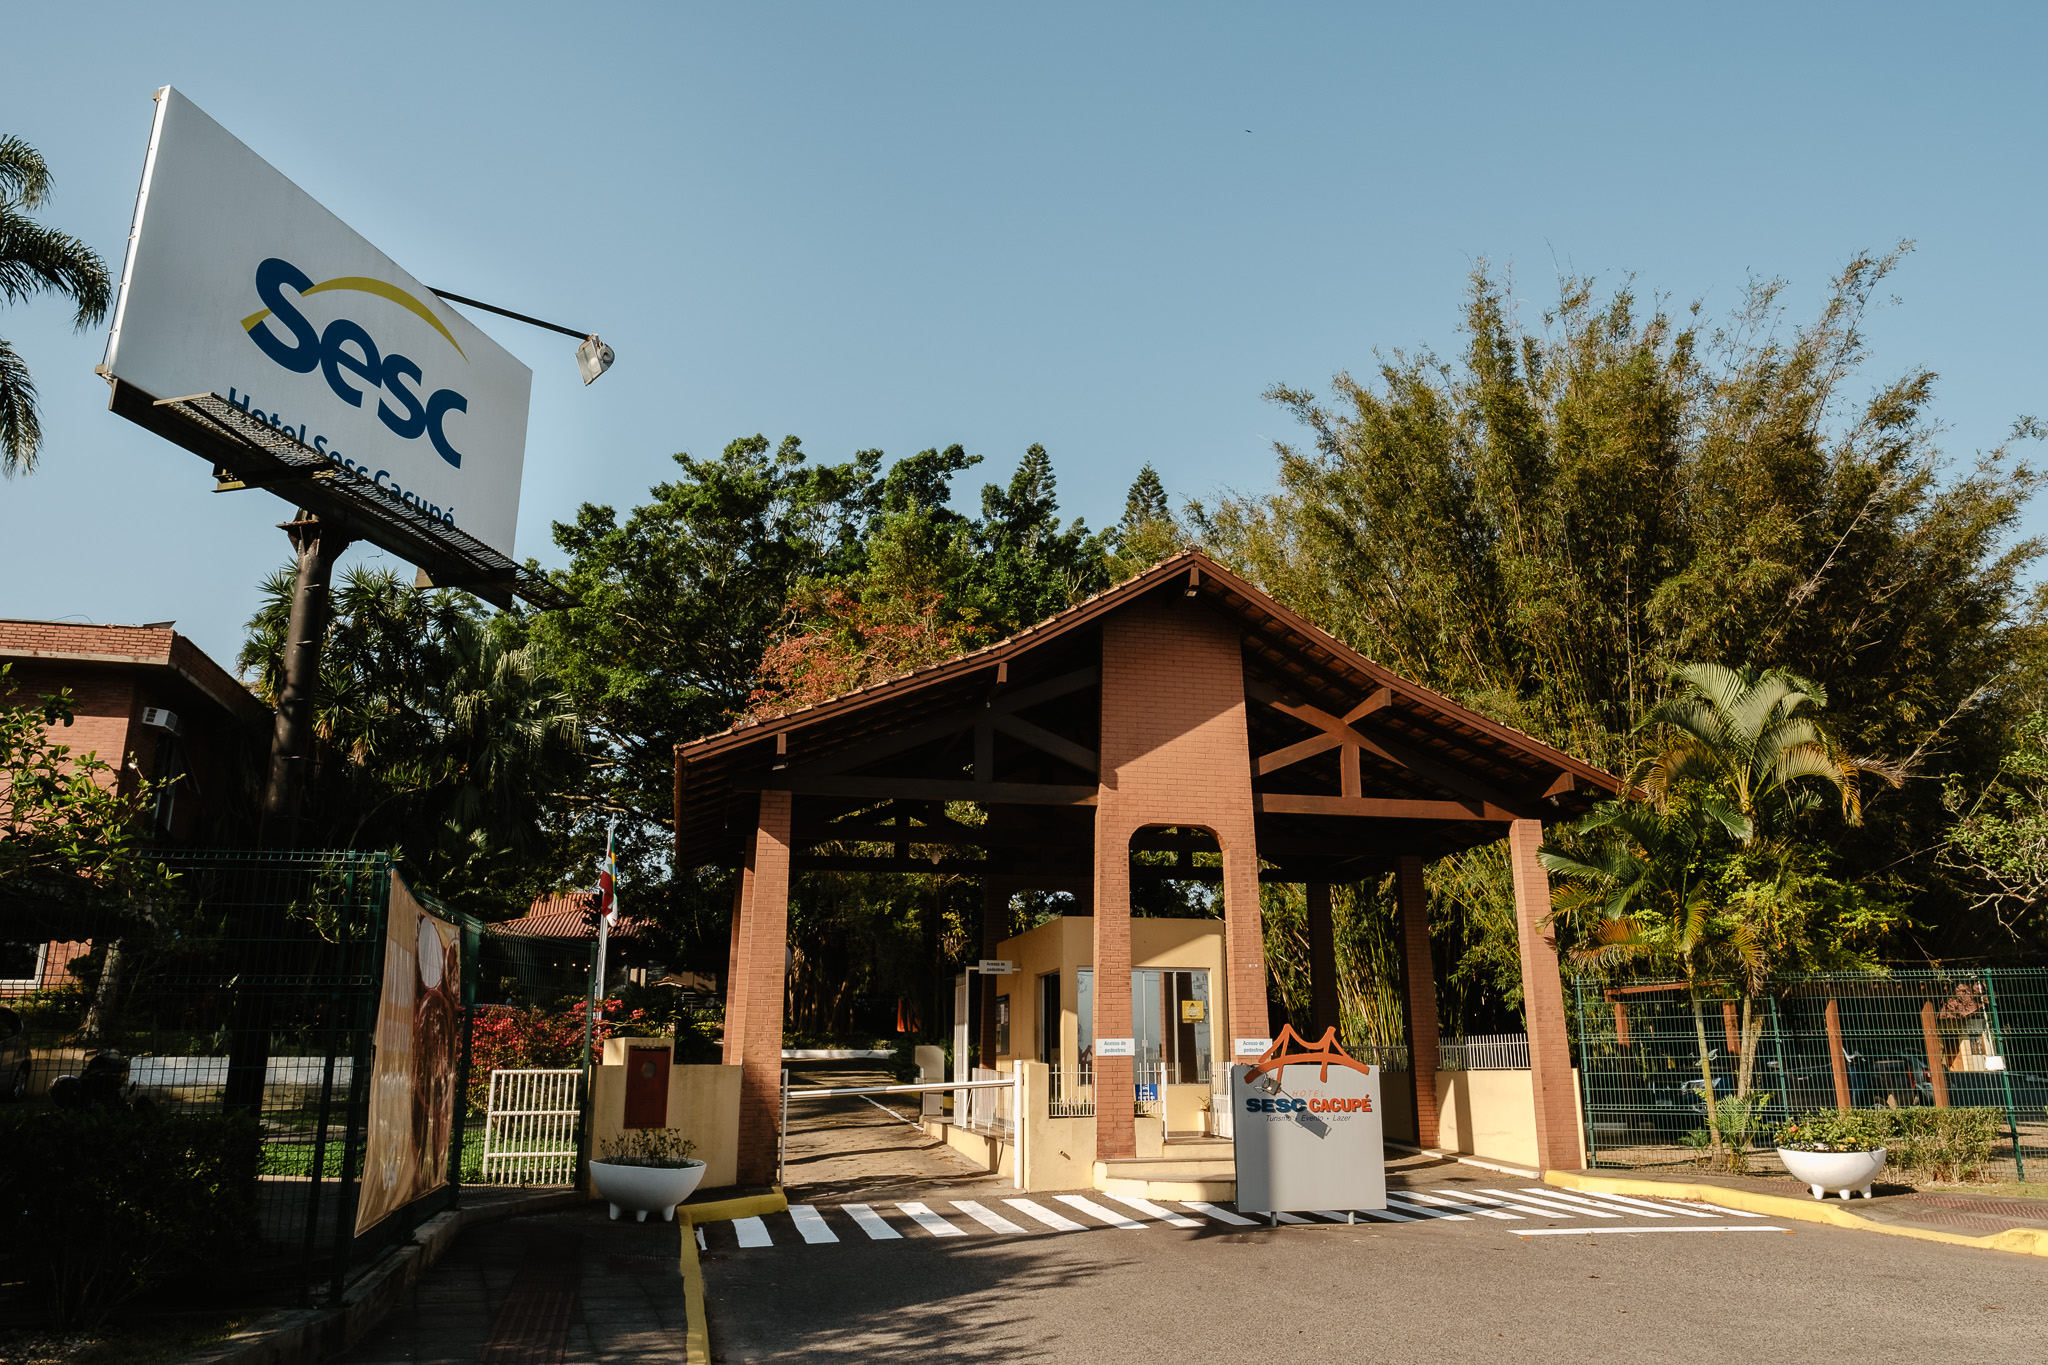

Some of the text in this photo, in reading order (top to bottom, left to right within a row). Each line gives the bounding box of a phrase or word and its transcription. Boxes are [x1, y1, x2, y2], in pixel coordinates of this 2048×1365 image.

[246, 257, 468, 469] Sesc
[1246, 1094, 1372, 1113] SESC CACUPÉ
[1292, 1090, 1325, 1098] HOTEL
